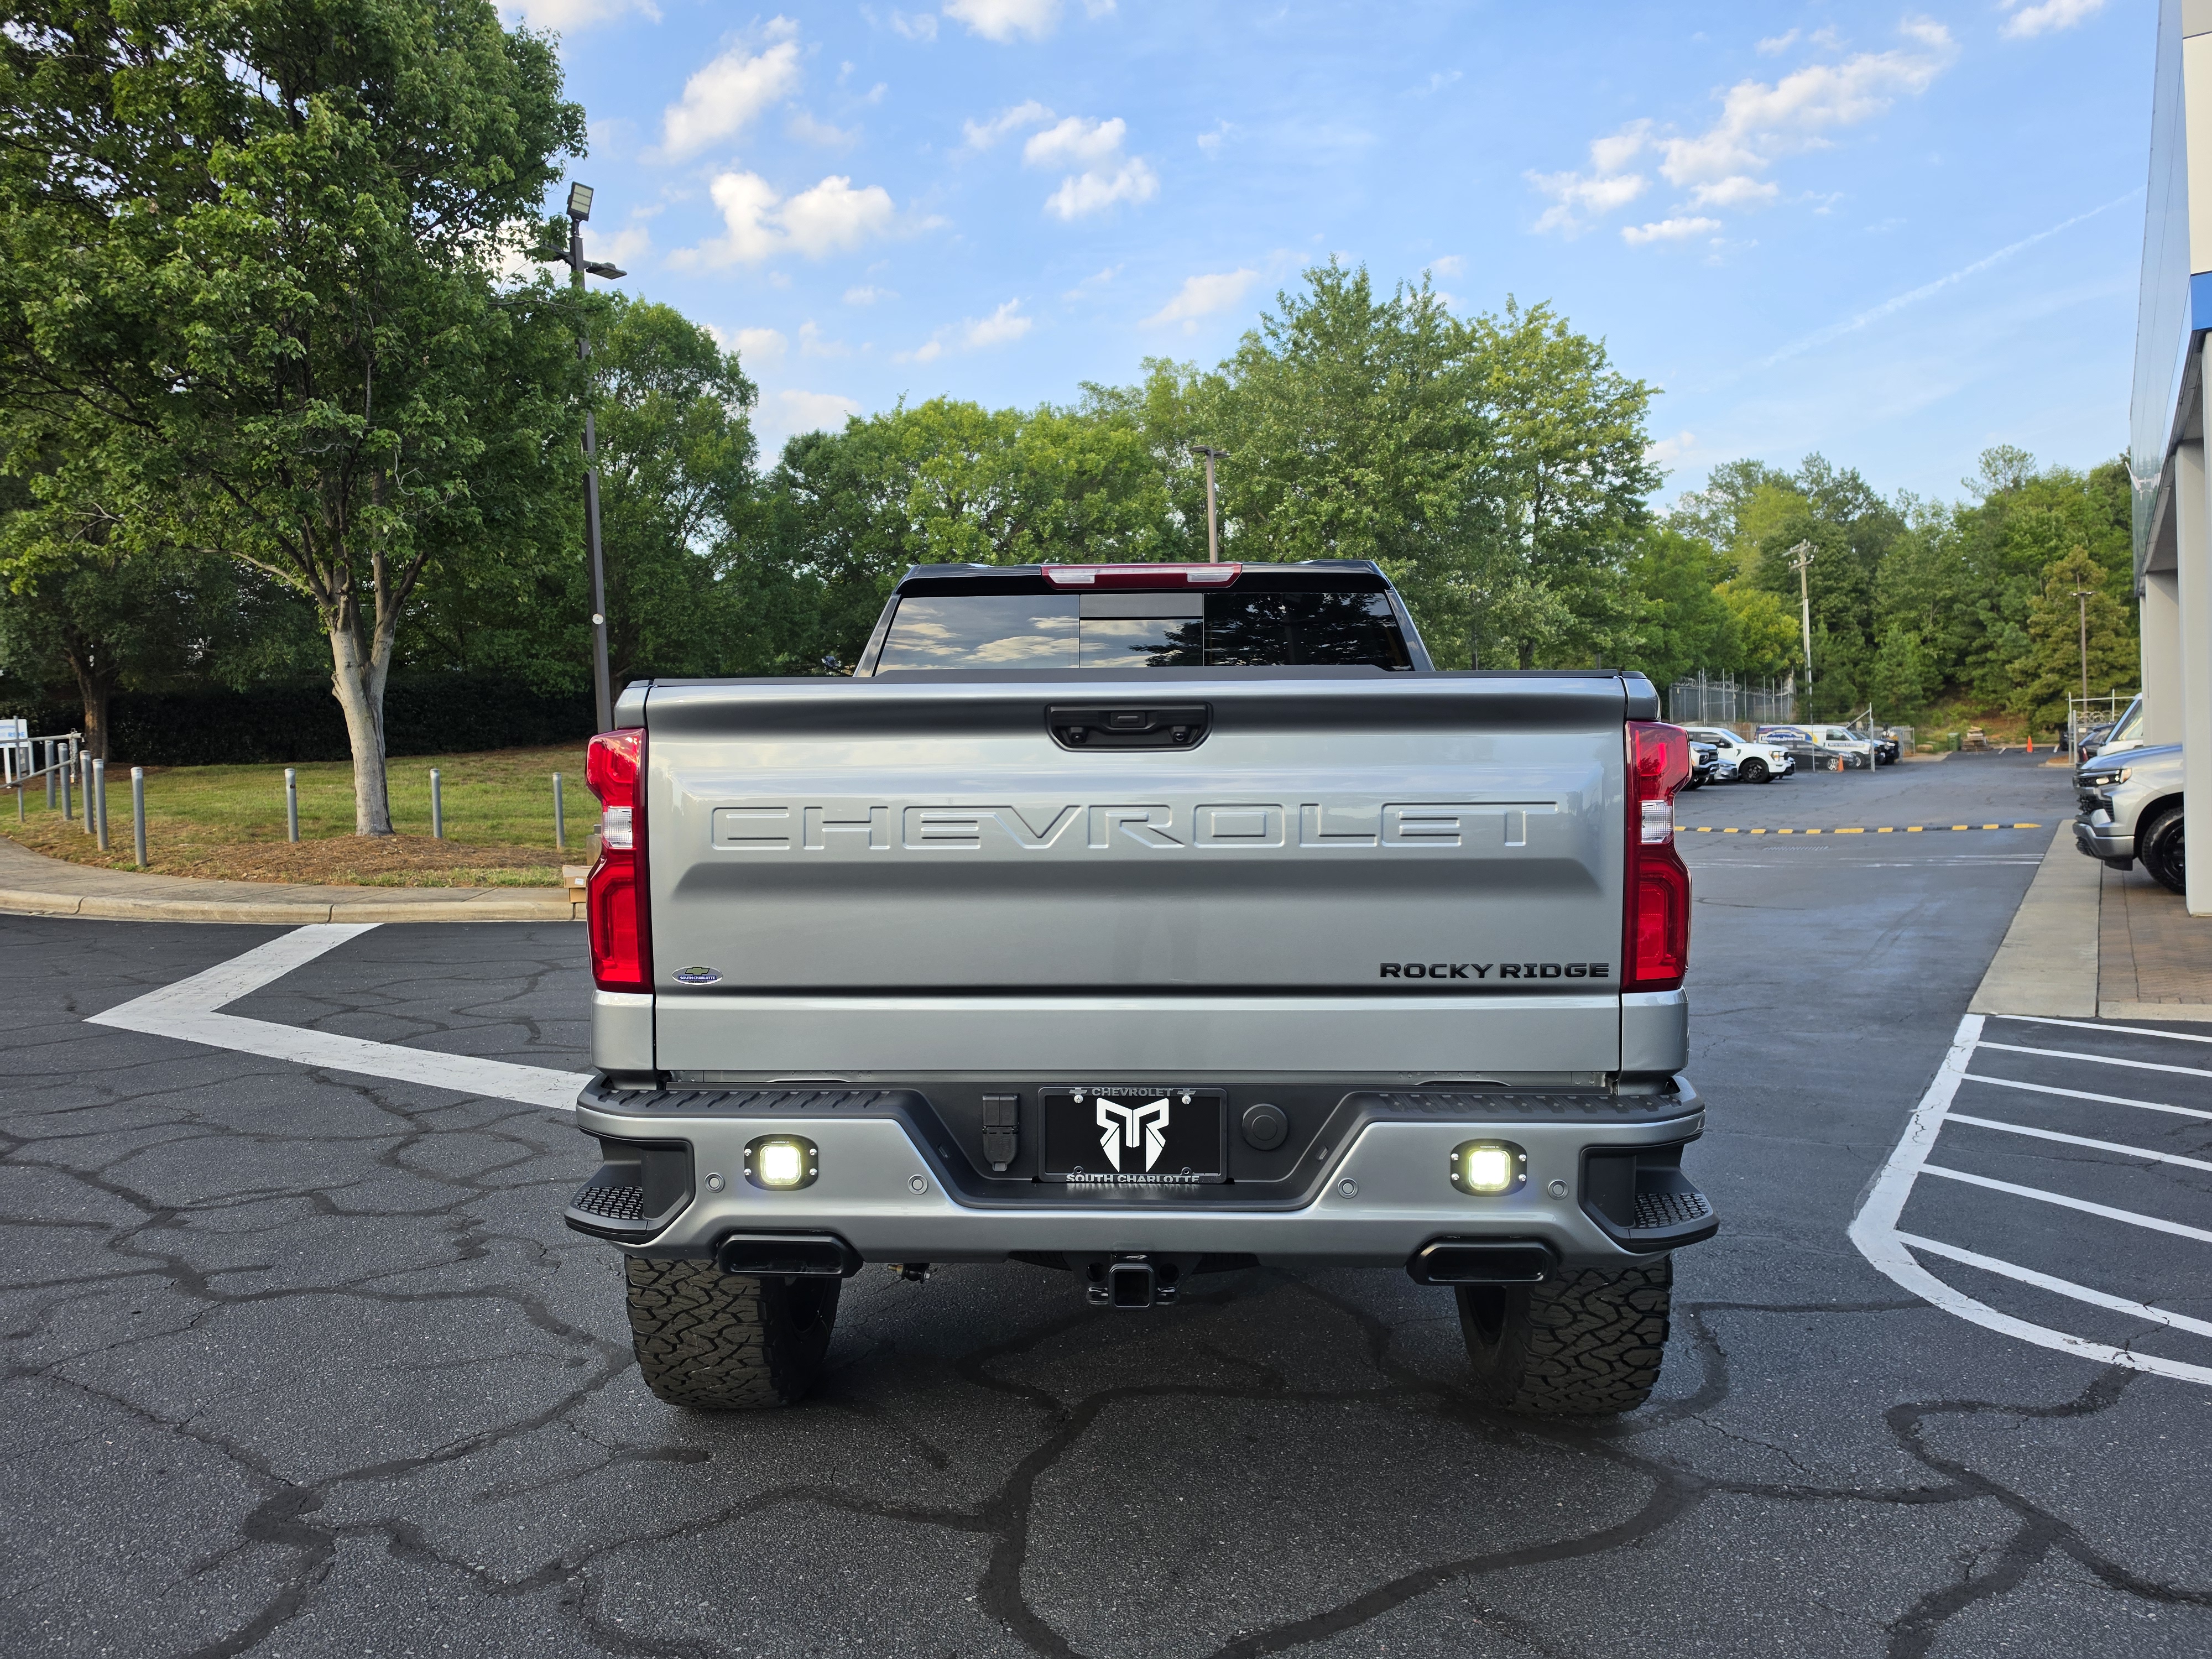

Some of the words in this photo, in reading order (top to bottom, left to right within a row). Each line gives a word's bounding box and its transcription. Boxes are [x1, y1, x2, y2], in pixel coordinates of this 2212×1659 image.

[711, 801, 1559, 850] CHEVROLET
[1380, 963, 1494, 978] ROCKY
[1500, 963, 1609, 978] RIDGE
[1091, 1088, 1173, 1097] CHEVROLET
[1066, 1174, 1114, 1182] SOUTH
[1117, 1175, 1199, 1183] CHARLOTTE
